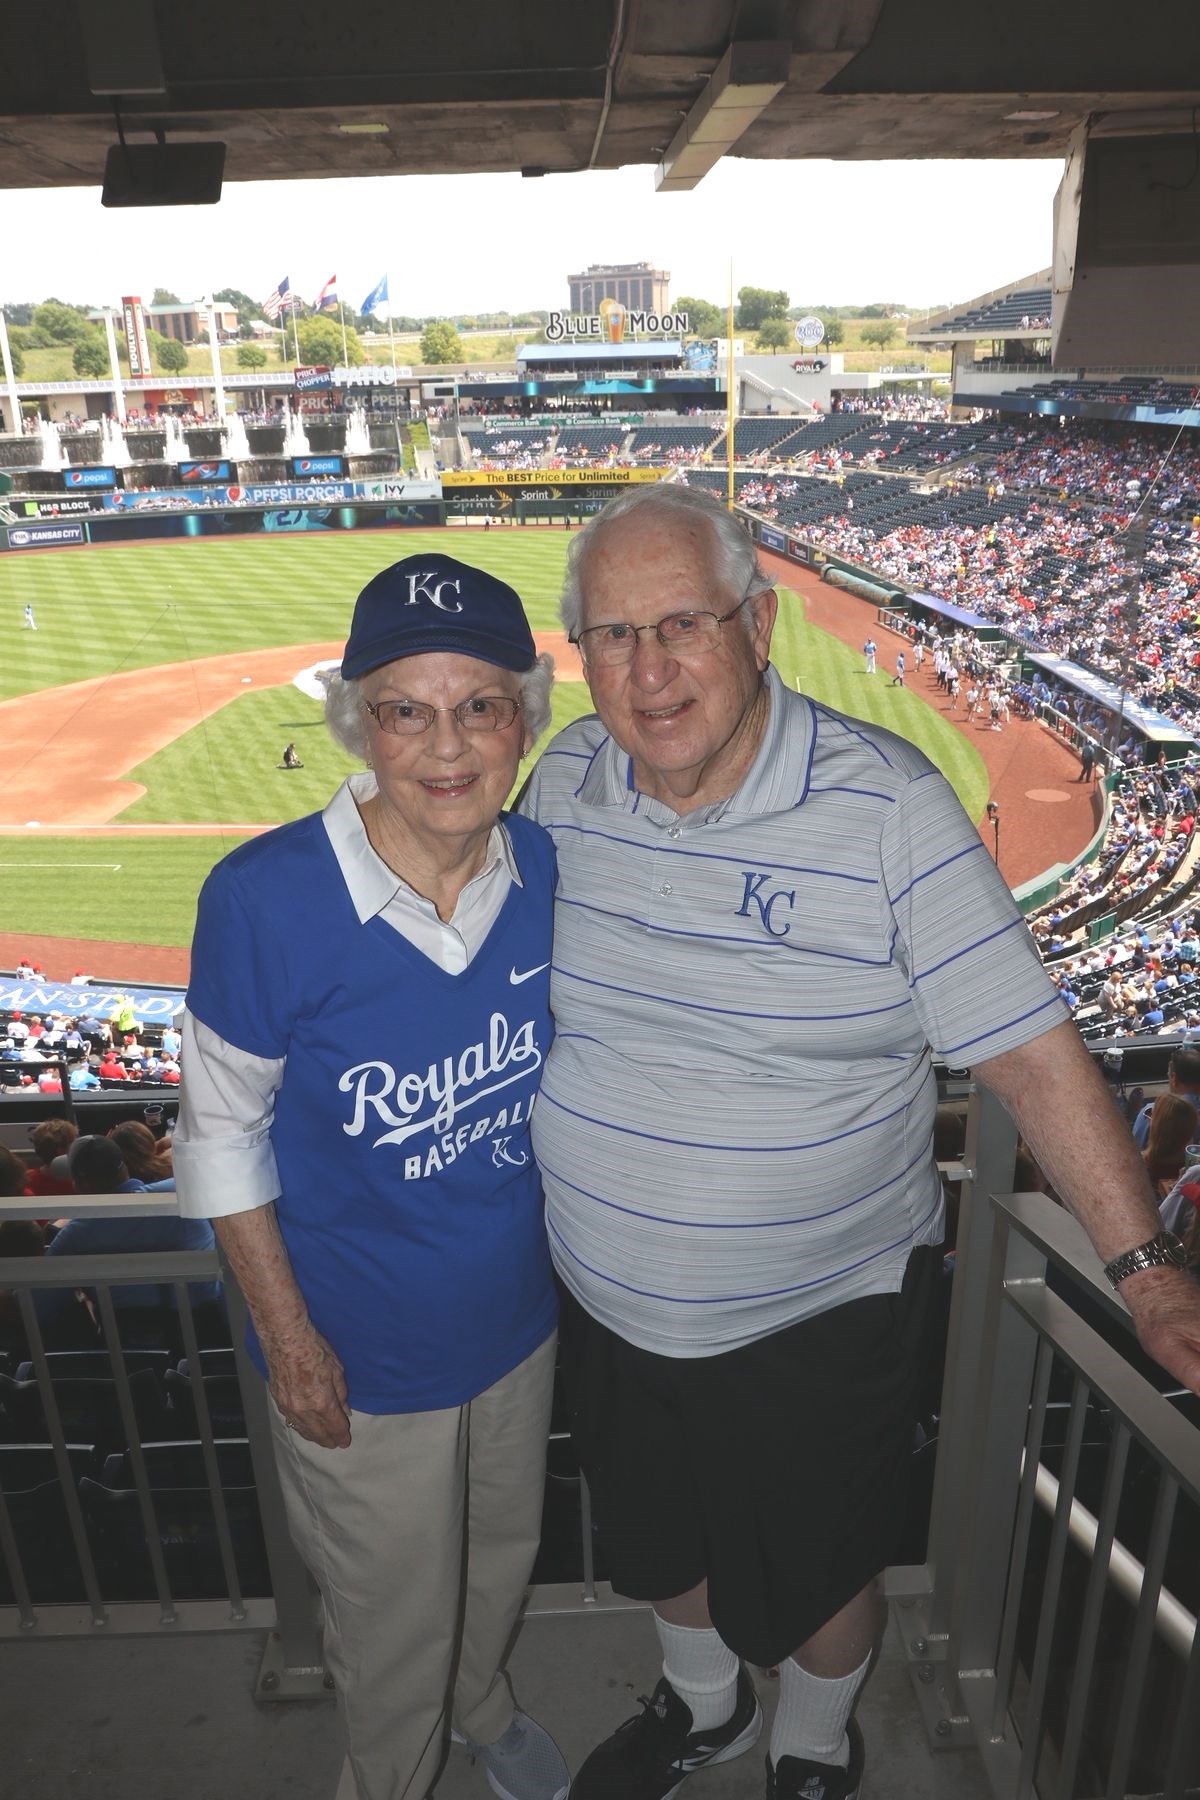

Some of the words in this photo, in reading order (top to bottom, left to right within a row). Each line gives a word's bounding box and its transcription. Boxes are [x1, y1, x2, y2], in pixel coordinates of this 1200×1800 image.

[546, 312, 600, 340] BLUE
[630, 313, 688, 333] MOON
[125, 310, 139, 369] BOULEVARD
[296, 369, 316, 379] PRICE
[297, 374, 330, 388] CHOPPER
[312, 462, 334, 471] pepsi
[84, 473, 108, 483] pepsi
[486, 473, 505, 483] The
[507, 473, 532, 482] BEST
[535, 472, 560, 482] Price
[562, 472, 577, 481] for
[579, 471, 630, 481] Unlimited
[384, 484, 405, 495] Ivy
[521, 490, 549, 501] Sprint
[60, 501, 90, 510] BLOCK
[452, 494, 496, 513] Sprint
[31, 531, 62, 541] KANSAS
[63, 529, 80, 538] CITY
[404, 572, 463, 613] KC
[734, 871, 796, 937] KC
[338, 1012, 541, 1148] Royals
